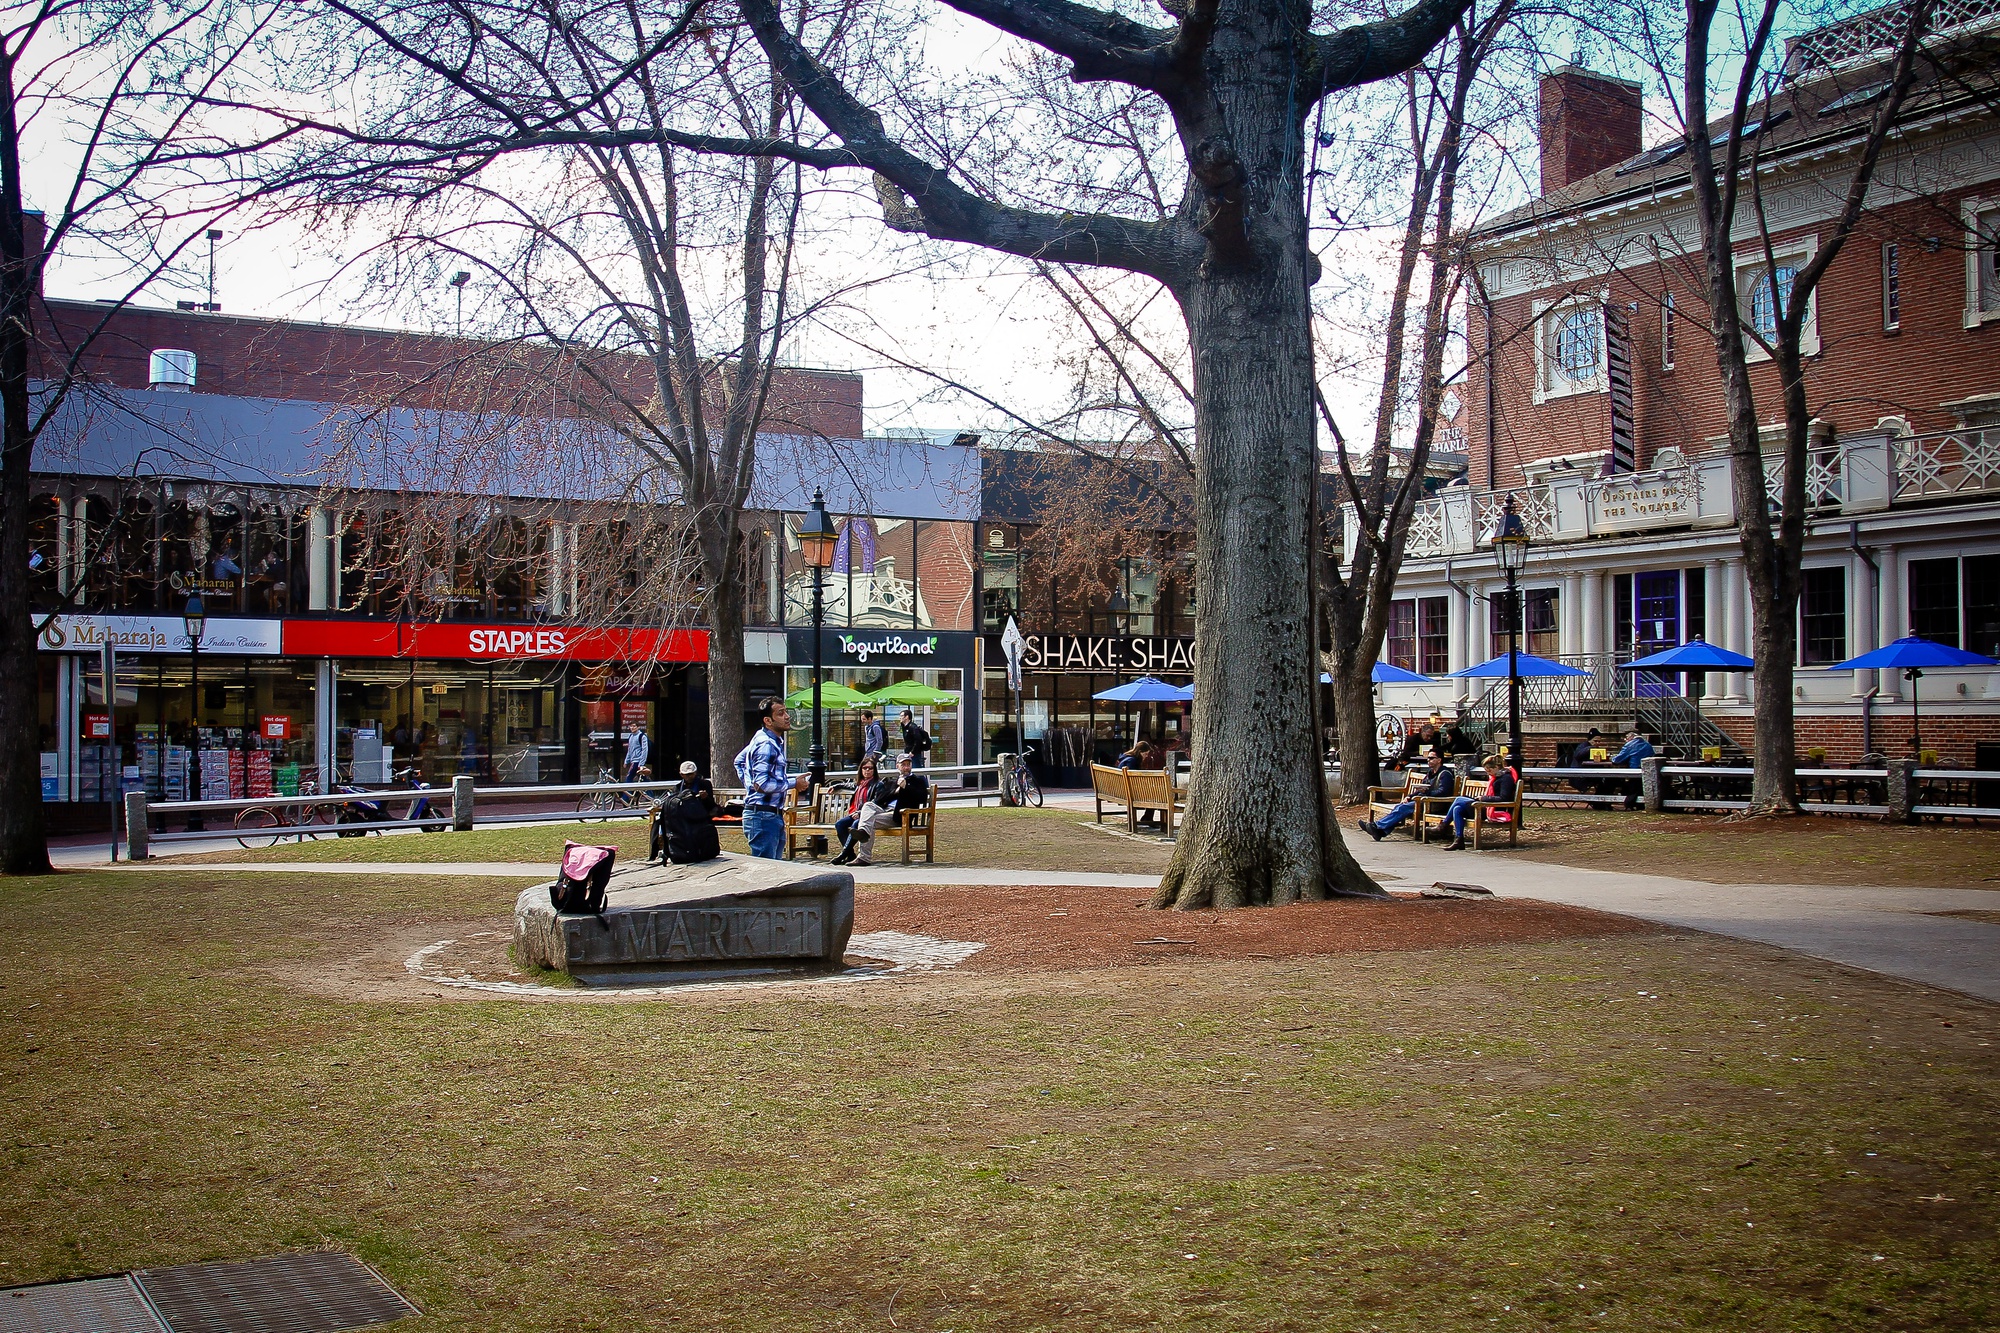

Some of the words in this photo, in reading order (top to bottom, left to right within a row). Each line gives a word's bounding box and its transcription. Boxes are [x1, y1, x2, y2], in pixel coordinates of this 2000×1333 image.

[1440, 426, 1462, 440] THE
[1429, 437, 1469, 453] CHARLE
[1603, 507, 1626, 517] THE
[73, 625, 167, 651] Maharaja
[203, 636, 236, 648] Indian
[236, 635, 268, 648] Cuisine
[468, 629, 566, 654] STAPLES
[838, 634, 934, 663] Yogurtland
[1024, 635, 1125, 668] SHAKE
[507, 699, 529, 708] AKE
[621, 908, 820, 961] MARKET
